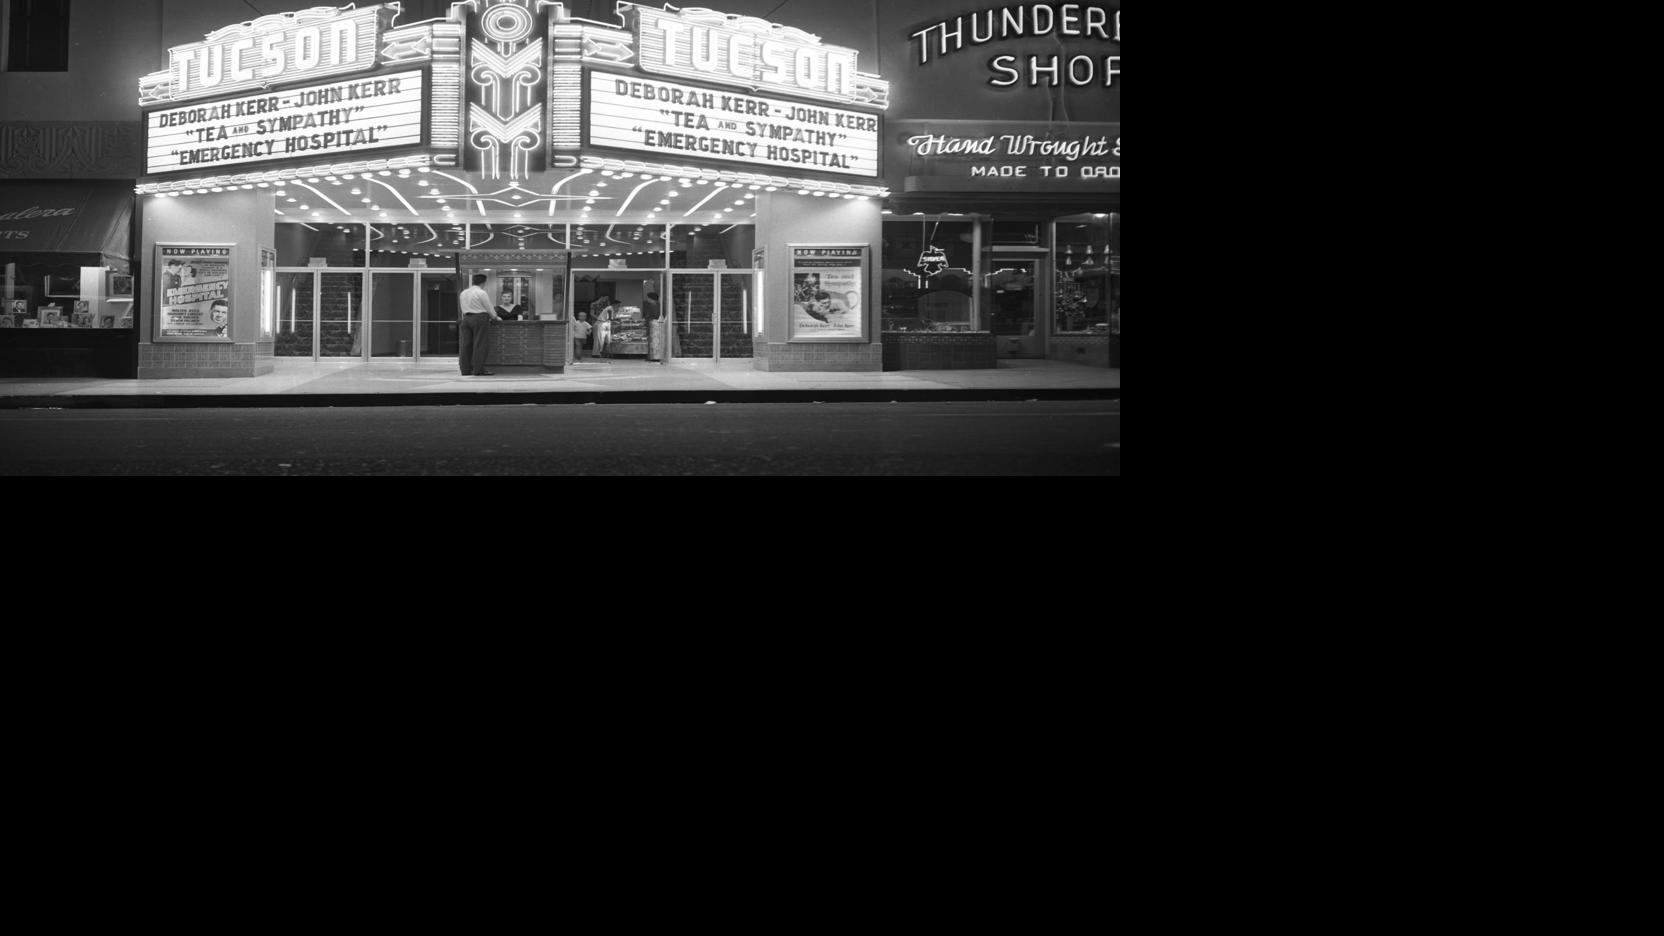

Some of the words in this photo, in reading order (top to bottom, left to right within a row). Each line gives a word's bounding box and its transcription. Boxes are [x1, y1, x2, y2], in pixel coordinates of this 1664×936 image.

[174, 19, 357, 92] TUCSON
[656, 19, 851, 95] TUCSON
[911, 3, 1120, 64] THUNDER
[159, 104, 232, 128] DEBORAH
[236, 96, 279, 117] KERR
[294, 86, 343, 109] JOHN
[348, 78, 401, 99] KERR
[615, 79, 714, 109] DEBORAH
[721, 96, 769, 117] KERR
[785, 106, 829, 126] JOHN
[835, 113, 877, 132] KERR
[718, 121, 737, 130] AND
[232, 125, 249, 134] AND
[907, 134, 997, 156] Hand
[1000, 134, 1109, 161] Wrought
[971, 166, 1027, 177] MADE
[1040, 166, 1068, 177] TO
